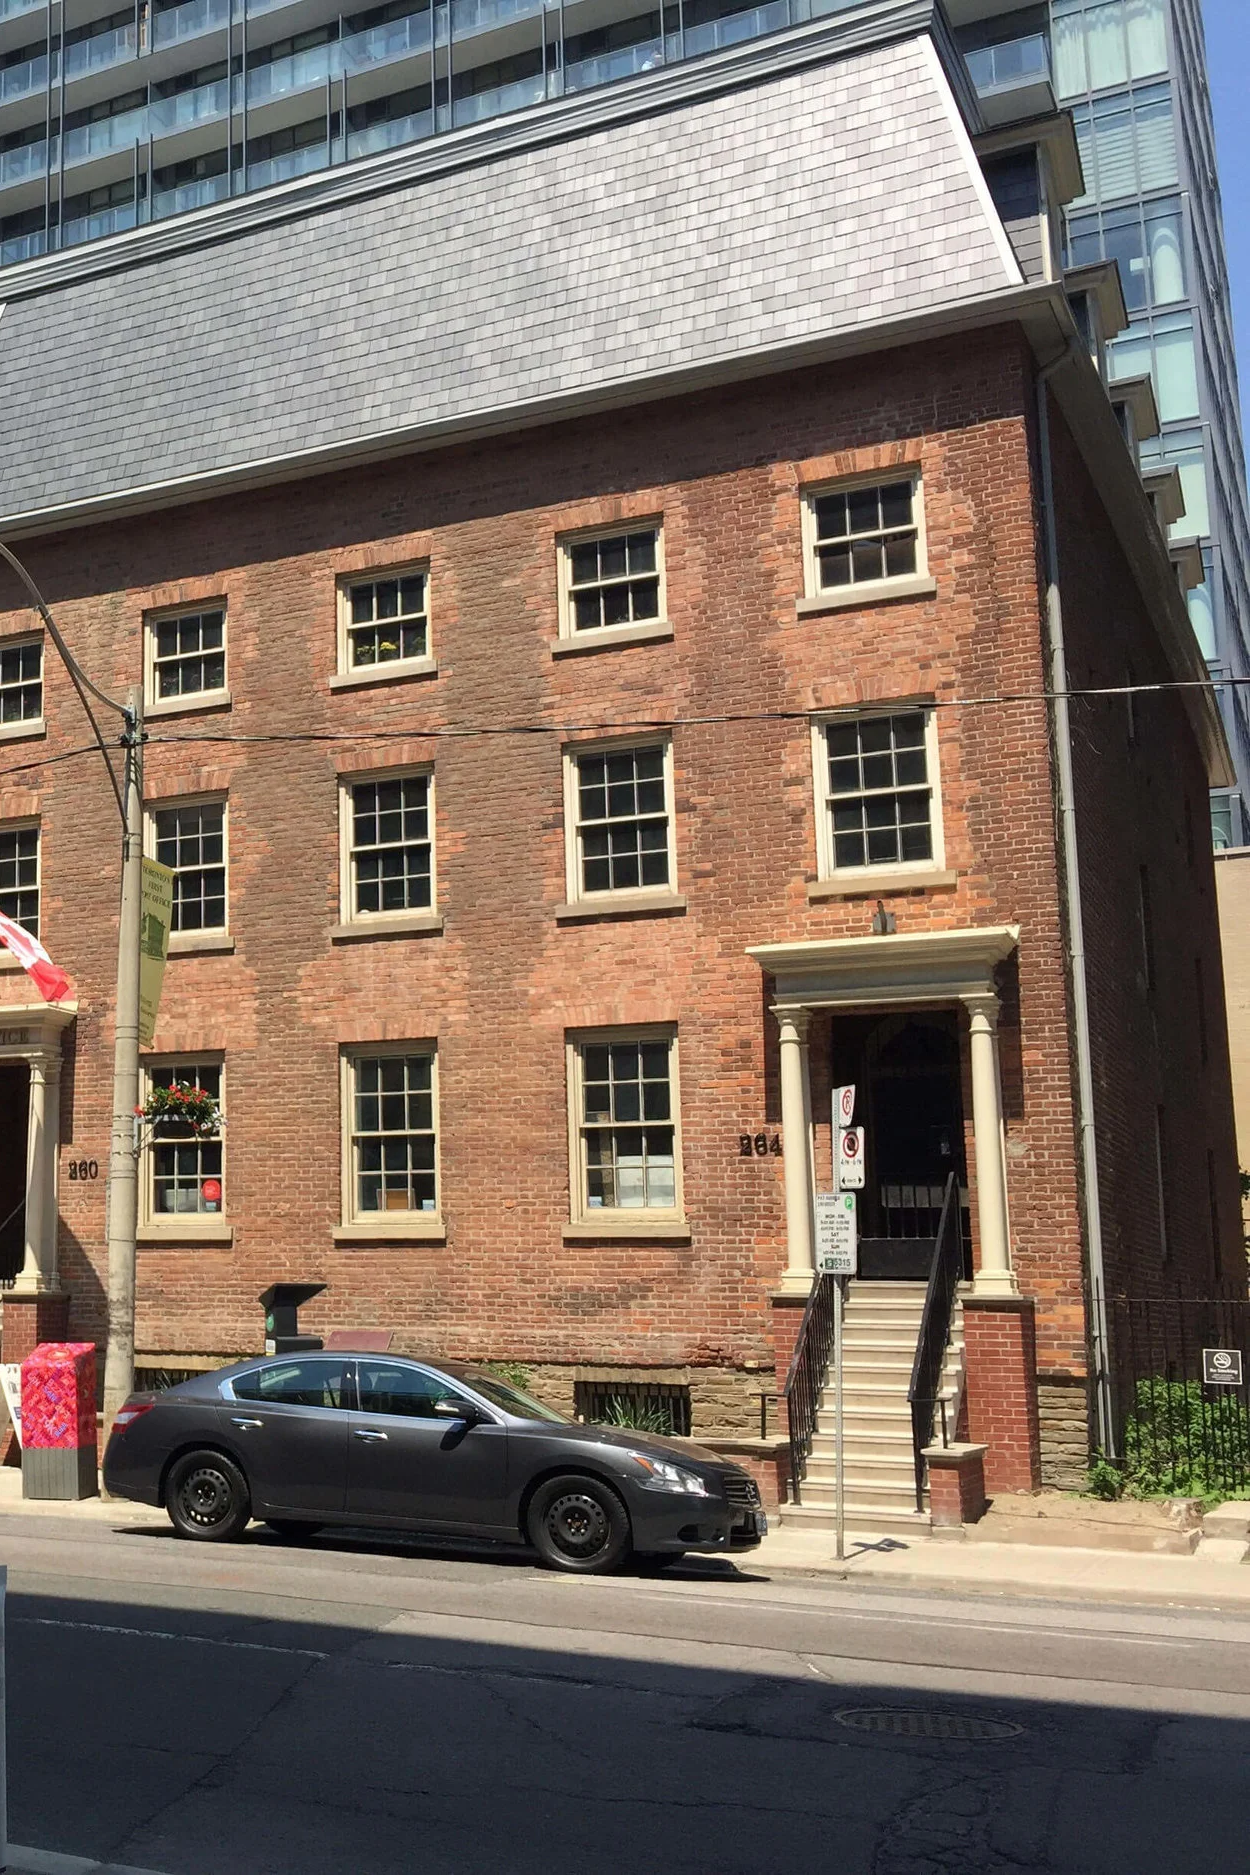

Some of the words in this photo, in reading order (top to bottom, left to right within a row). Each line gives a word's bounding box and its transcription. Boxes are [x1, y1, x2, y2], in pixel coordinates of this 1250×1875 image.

[148, 881, 163, 893] FIRST
[152, 894, 171, 908] OFFICE
[739, 1132, 783, 1156] 264
[68, 1159, 98, 1180] 260
